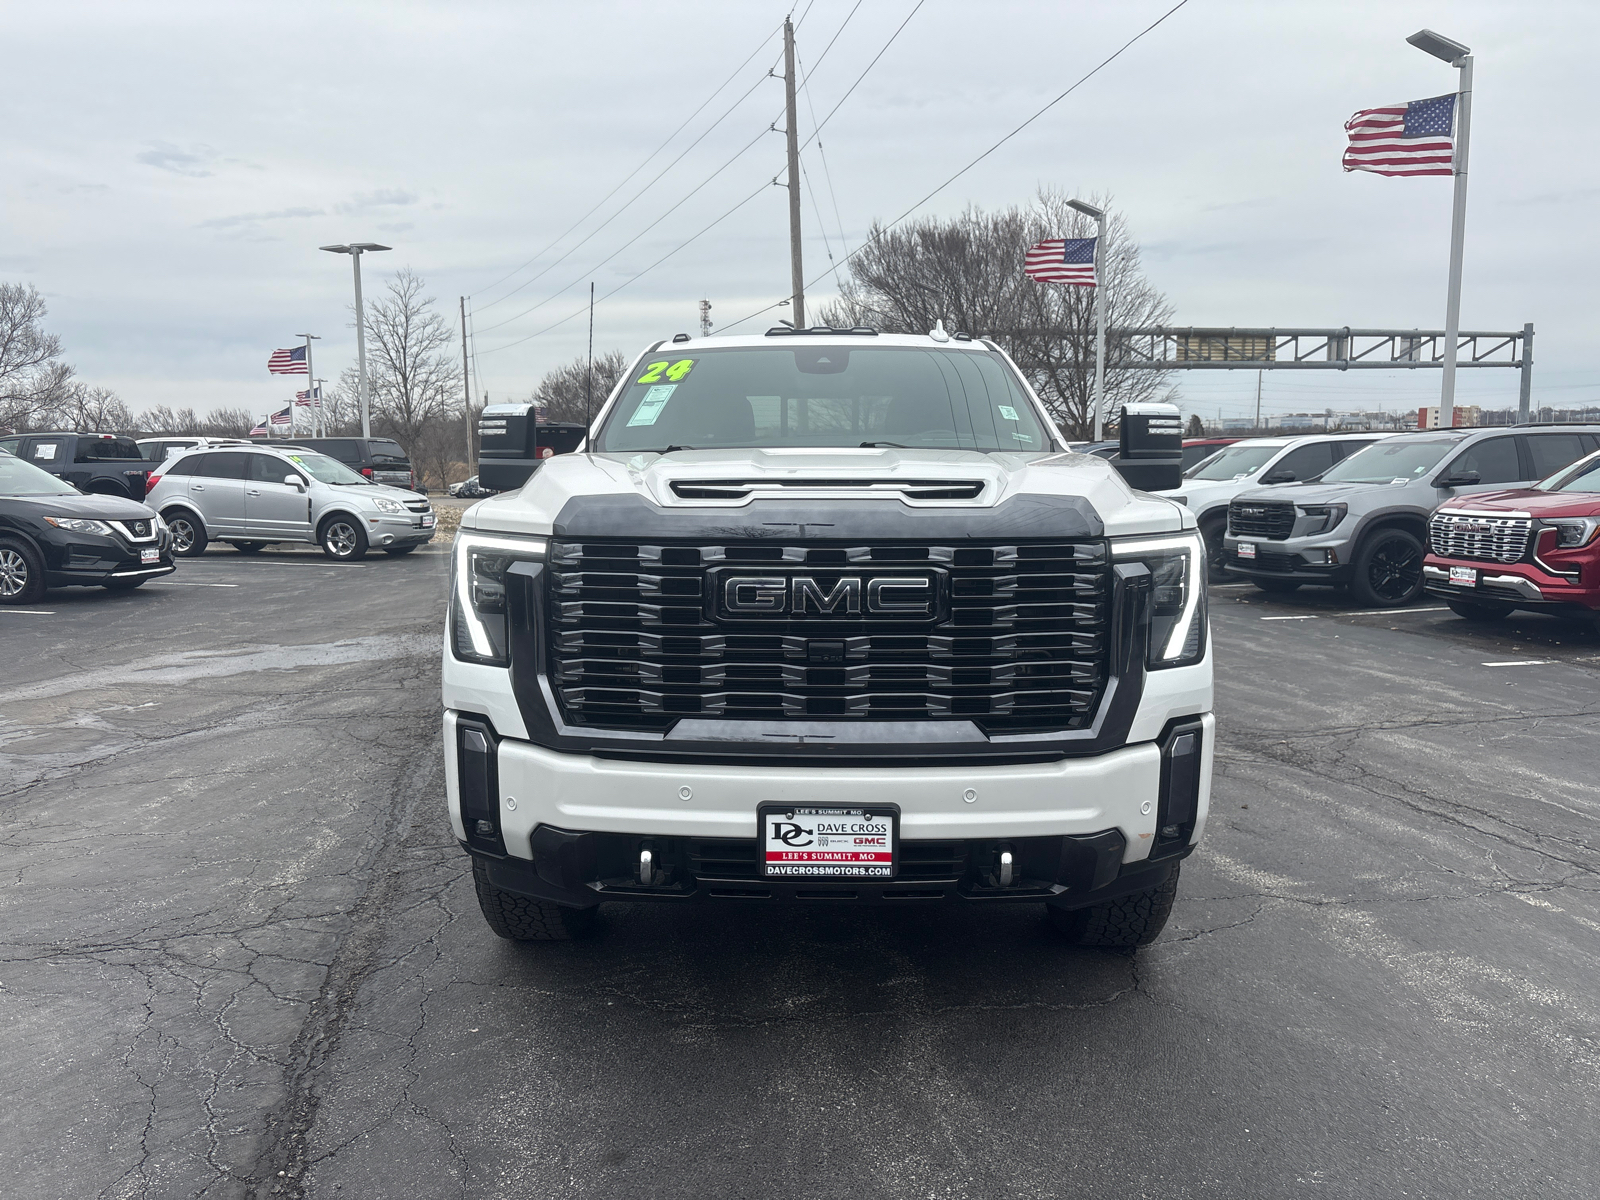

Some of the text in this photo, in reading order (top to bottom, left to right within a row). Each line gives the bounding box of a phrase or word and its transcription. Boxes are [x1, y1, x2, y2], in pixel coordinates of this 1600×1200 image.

[638, 360, 694, 384] 24
[1454, 523, 1491, 534] GMC
[725, 577, 929, 613] GMC
[818, 823, 887, 833] DAVE CROSS
[771, 822, 814, 847] DC
[853, 837, 886, 845] GMC
[782, 852, 808, 860] LEE'S
[811, 853, 855, 861] SUMMIT,
[768, 866, 890, 876] DAVECROSSMOTORS.COM
